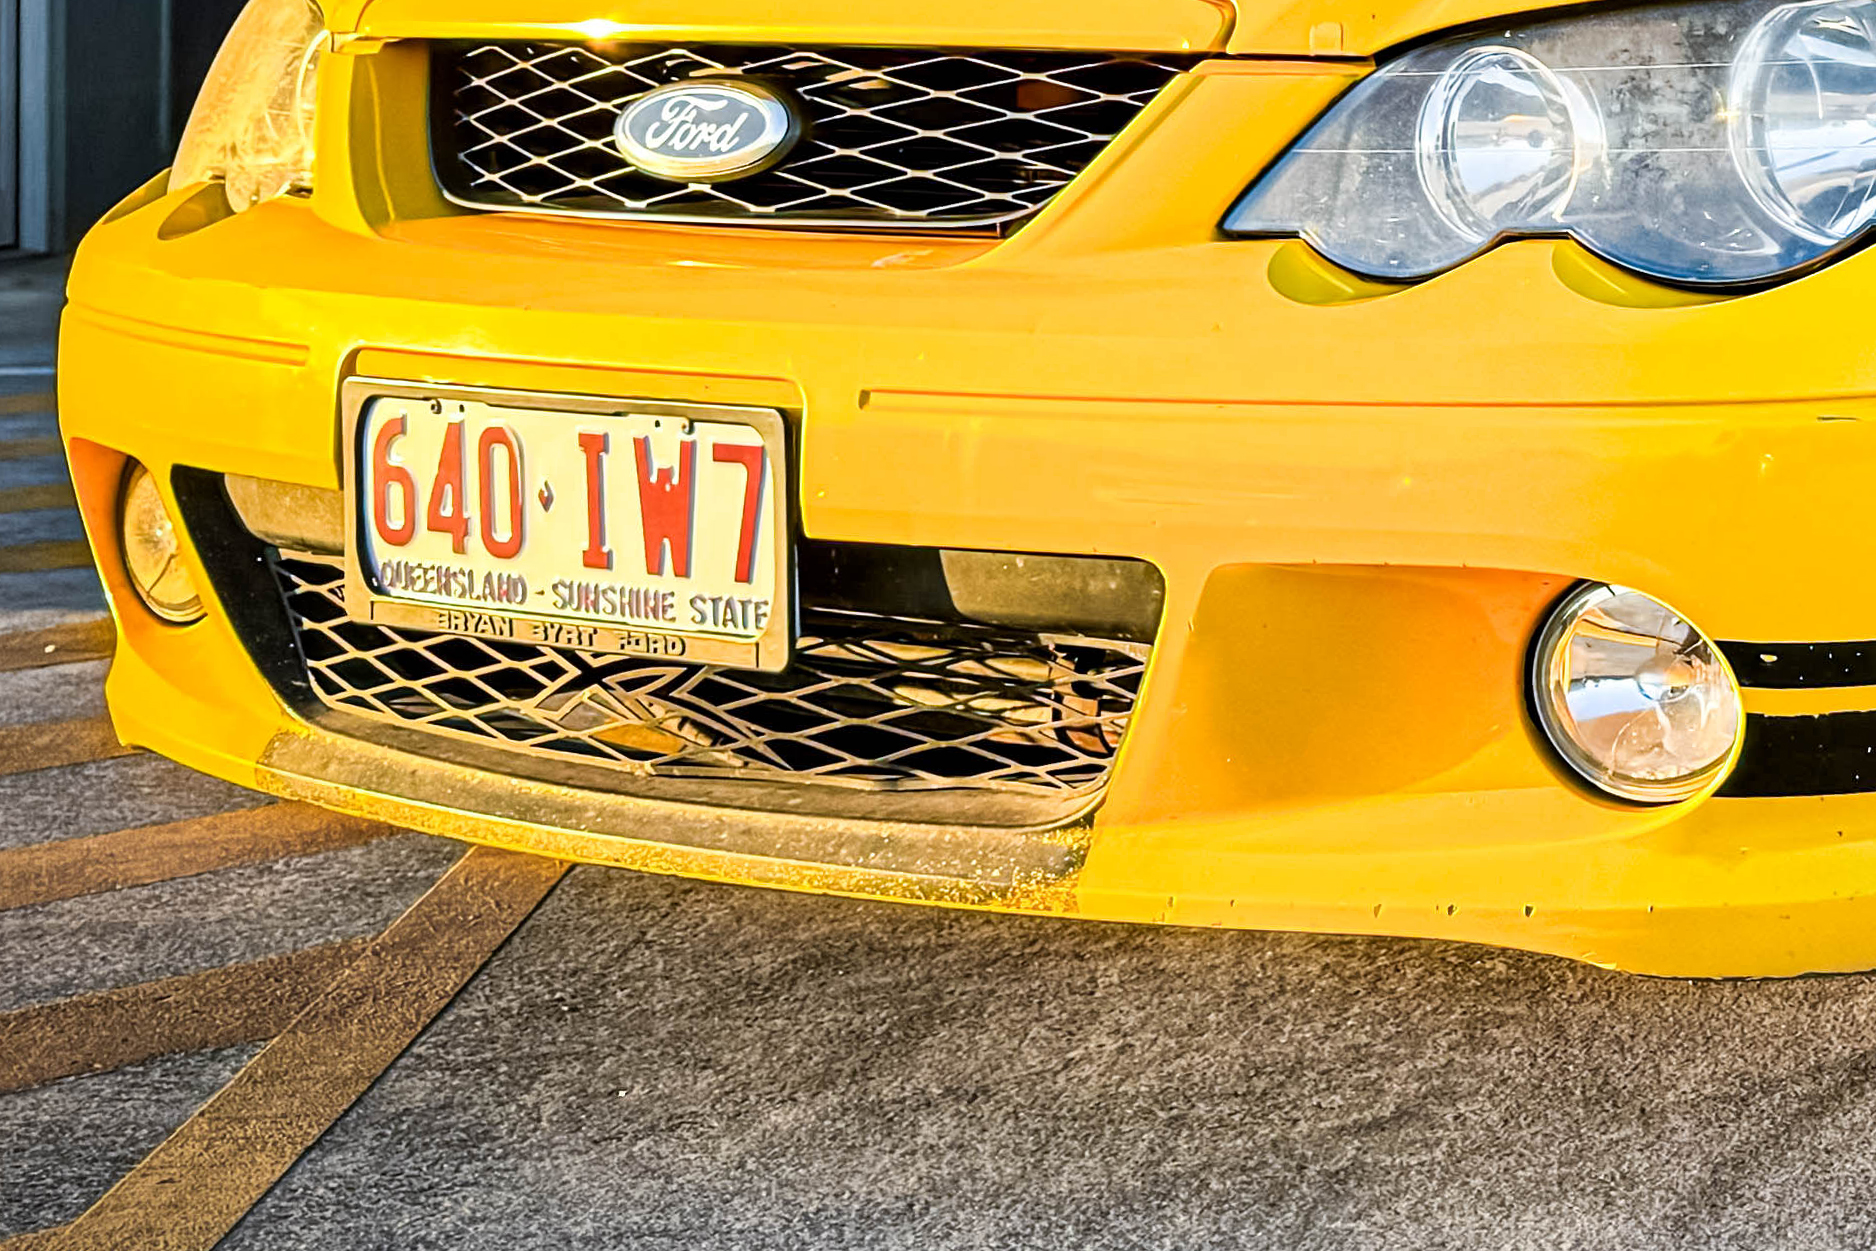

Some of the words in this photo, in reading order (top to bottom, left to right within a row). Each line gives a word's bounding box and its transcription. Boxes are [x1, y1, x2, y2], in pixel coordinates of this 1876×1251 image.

[645, 95, 748, 152] Ford
[373, 413, 525, 559] 640
[578, 431, 767, 585] IW7
[380, 559, 528, 605] QUEENSLAND
[552, 578, 676, 622] SUNSHINE
[689, 594, 769, 630] STATE
